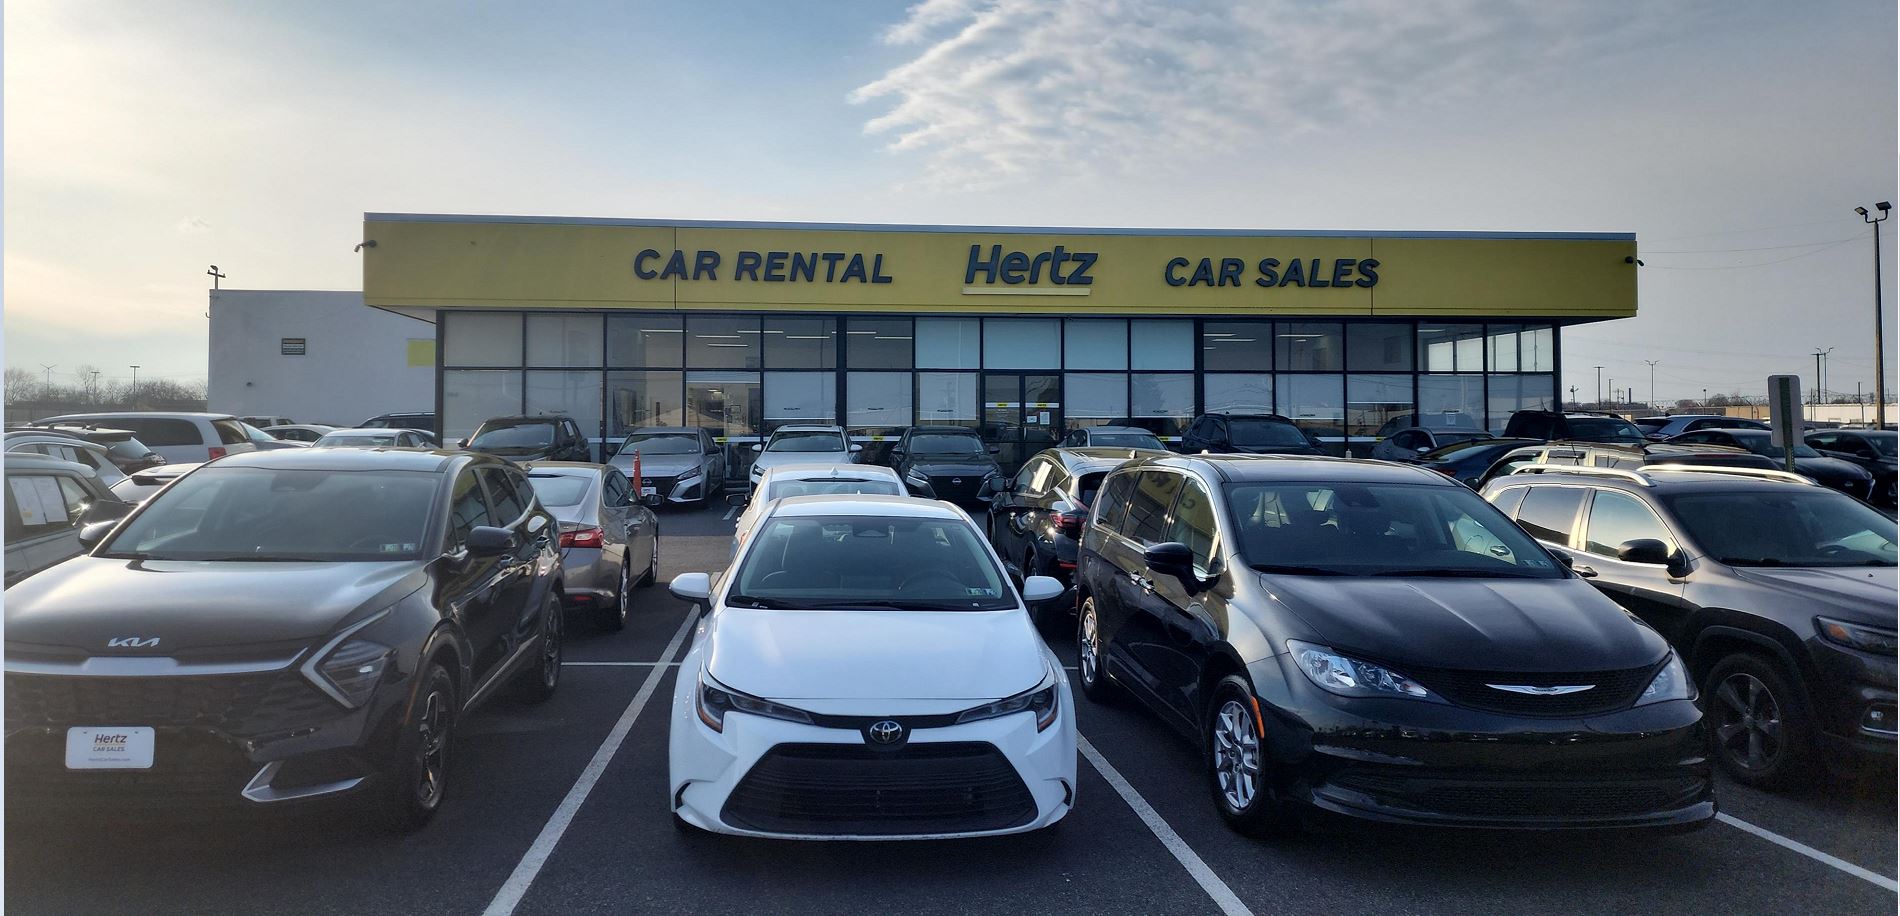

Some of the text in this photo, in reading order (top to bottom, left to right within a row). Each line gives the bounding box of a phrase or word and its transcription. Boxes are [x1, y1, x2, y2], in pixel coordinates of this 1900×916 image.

[634, 248, 893, 284] CAR RENTAL
[964, 244, 1099, 287] Hertz
[1164, 257, 1381, 289] CAR SALES
[108, 637, 161, 647] KIA
[94, 733, 128, 744] Hertz
